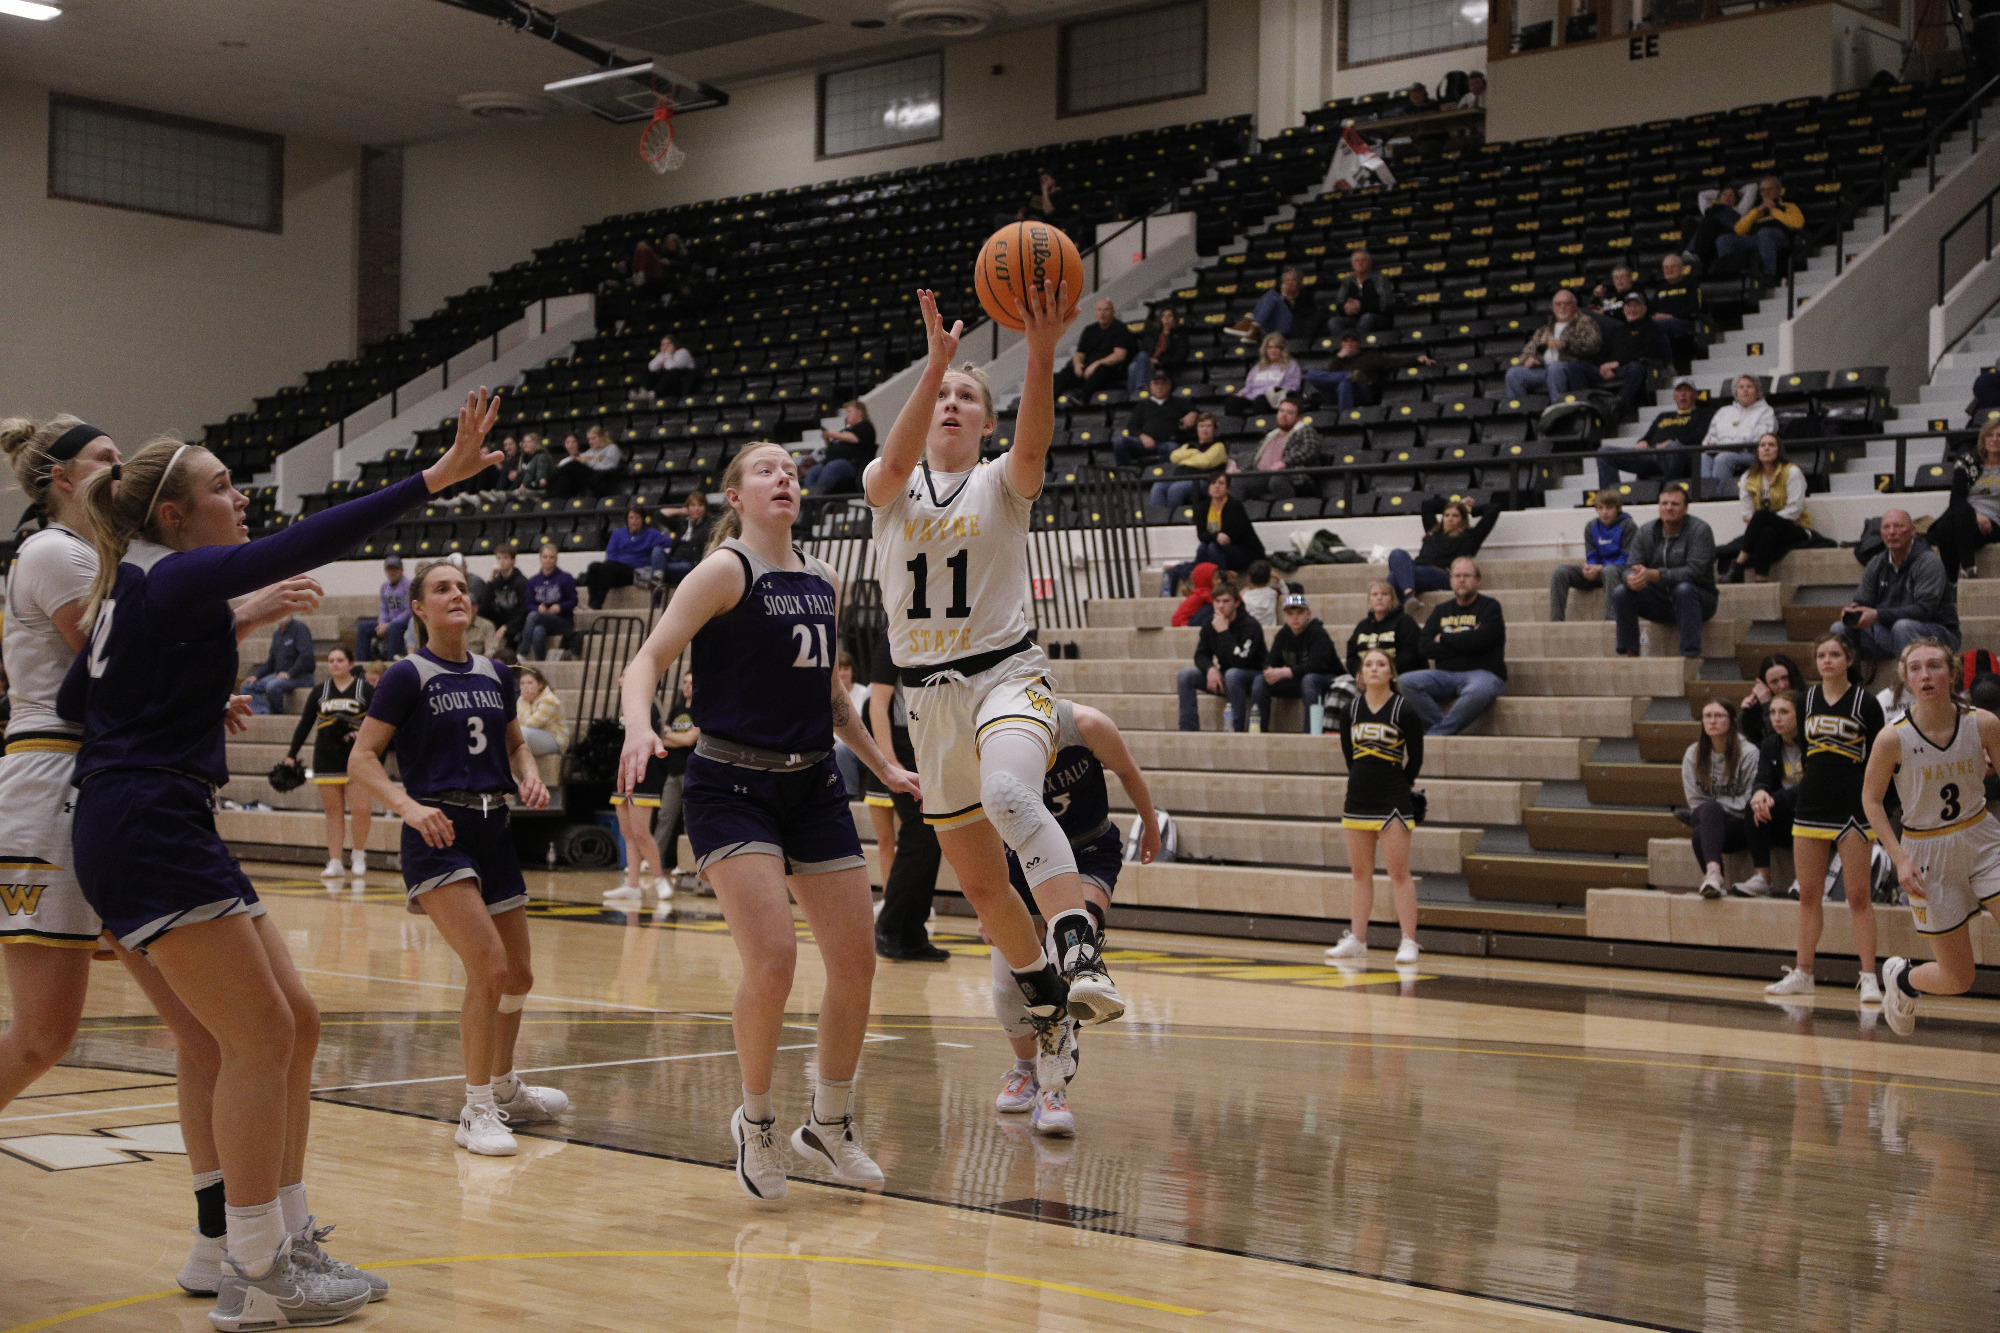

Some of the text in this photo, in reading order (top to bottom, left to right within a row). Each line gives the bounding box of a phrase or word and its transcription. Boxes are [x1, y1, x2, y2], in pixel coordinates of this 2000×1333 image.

[1629, 34, 1660, 61] EE
[994, 241, 1011, 281] EVO
[1028, 226, 1052, 292] Wilson
[903, 514, 981, 542] WAYNE
[906, 549, 971, 619] 11
[763, 594, 806, 616] SIOUX
[792, 623, 831, 668] 21
[909, 628, 972, 653] STATE
[320, 698, 361, 714] WSC
[429, 691, 473, 716] SIOUX
[467, 716, 488, 755] 3
[1351, 722, 1399, 744] WSC
[1805, 715, 1862, 739] WSC
[1057, 758, 1090, 788] FALLS
[1921, 758, 1976, 782] WAYNE
[1940, 783, 1962, 821] 3
[0, 884, 49, 916] W
